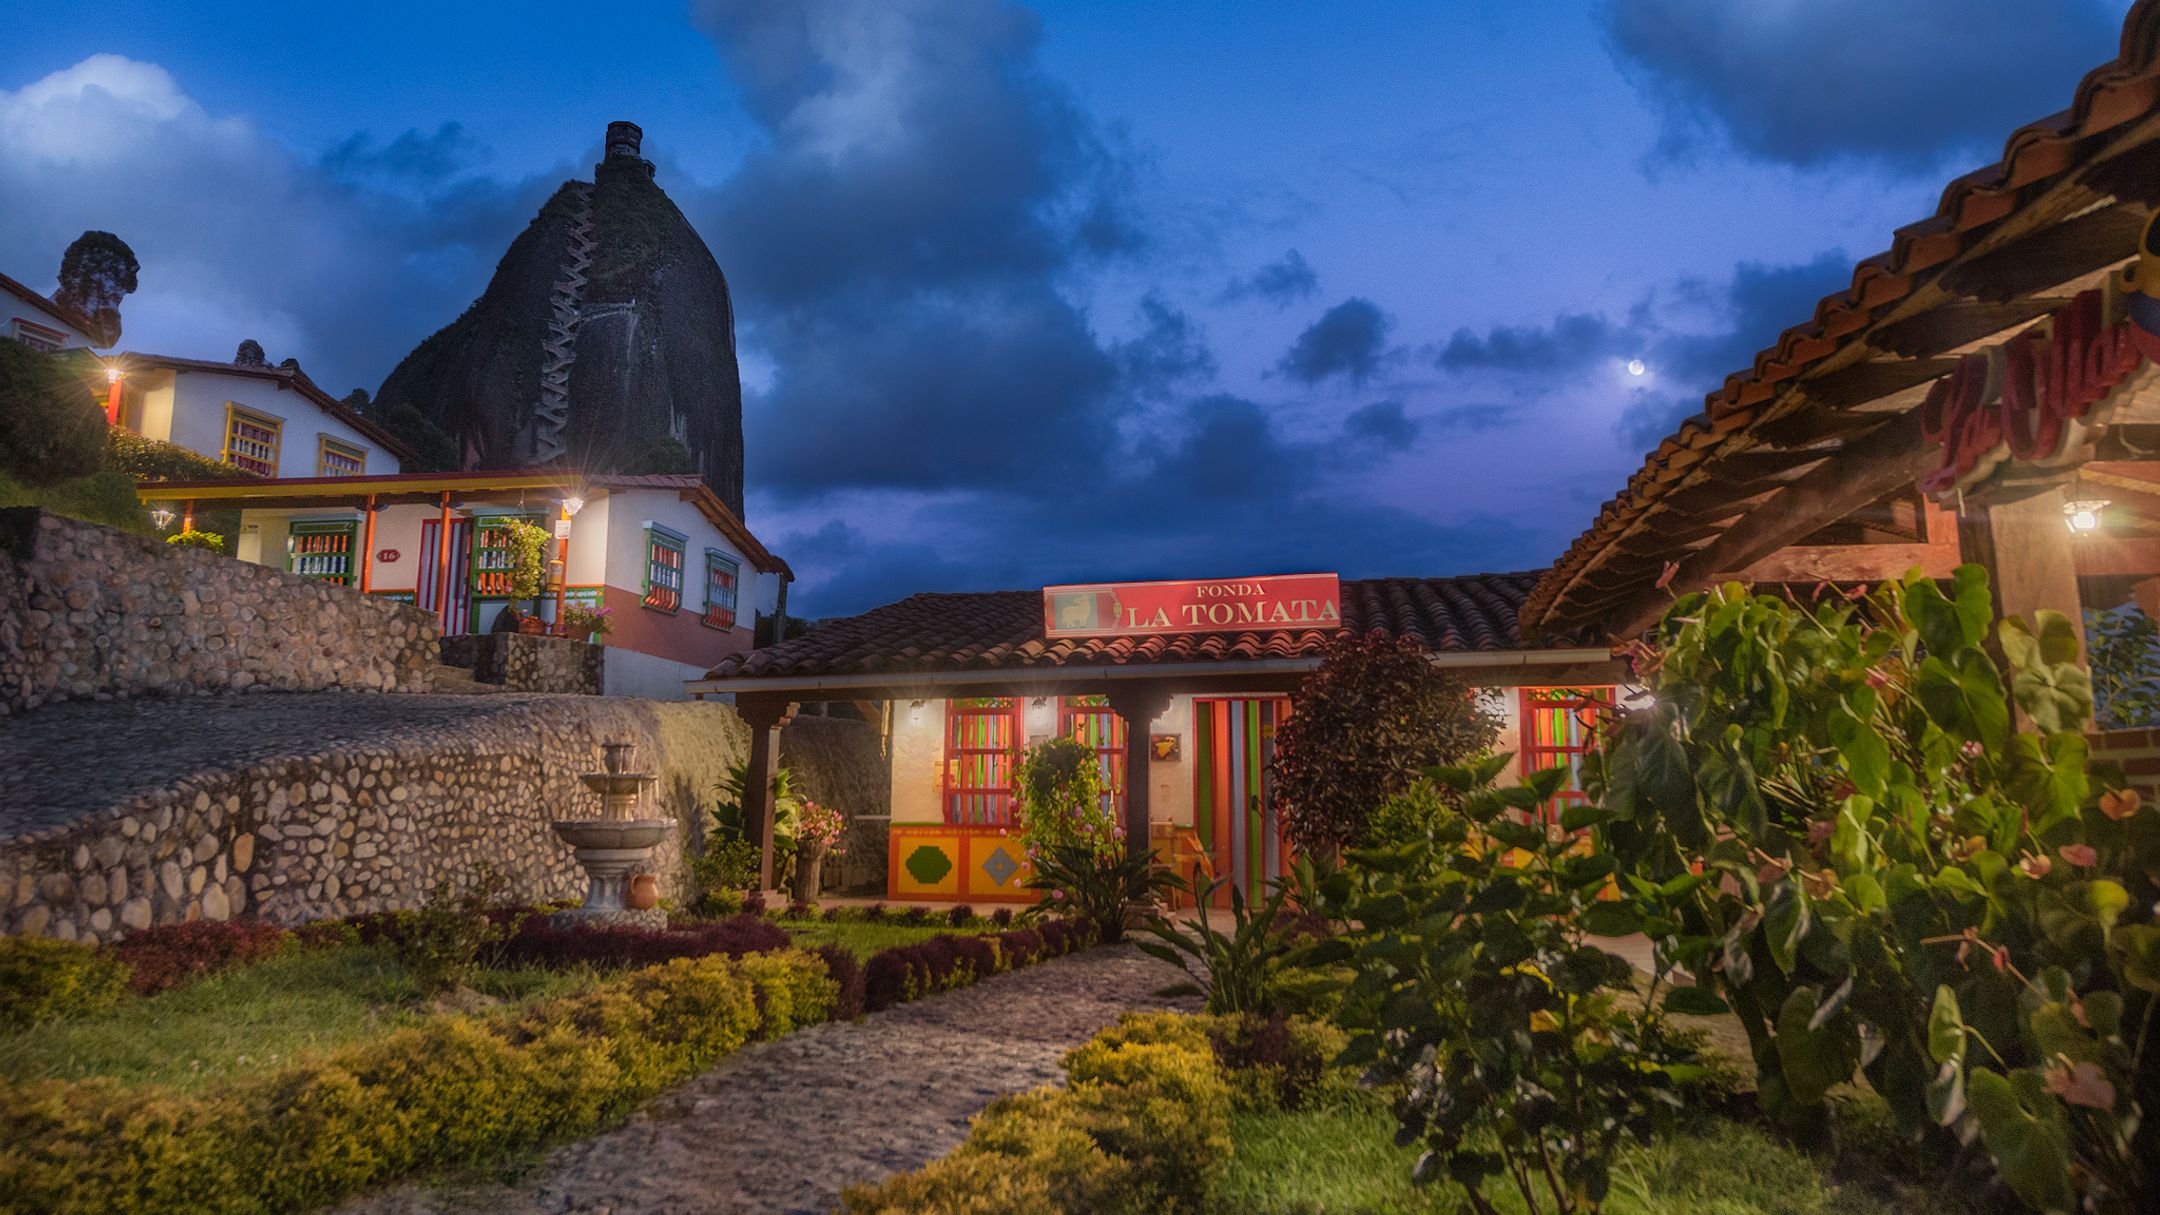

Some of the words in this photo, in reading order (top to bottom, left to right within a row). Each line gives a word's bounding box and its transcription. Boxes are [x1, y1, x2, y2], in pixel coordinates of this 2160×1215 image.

[383, 552, 396, 561] 16
[1196, 584, 1266, 598] FONDA
[1128, 607, 1171, 629] LA
[1182, 599, 1341, 626] TOMATA
